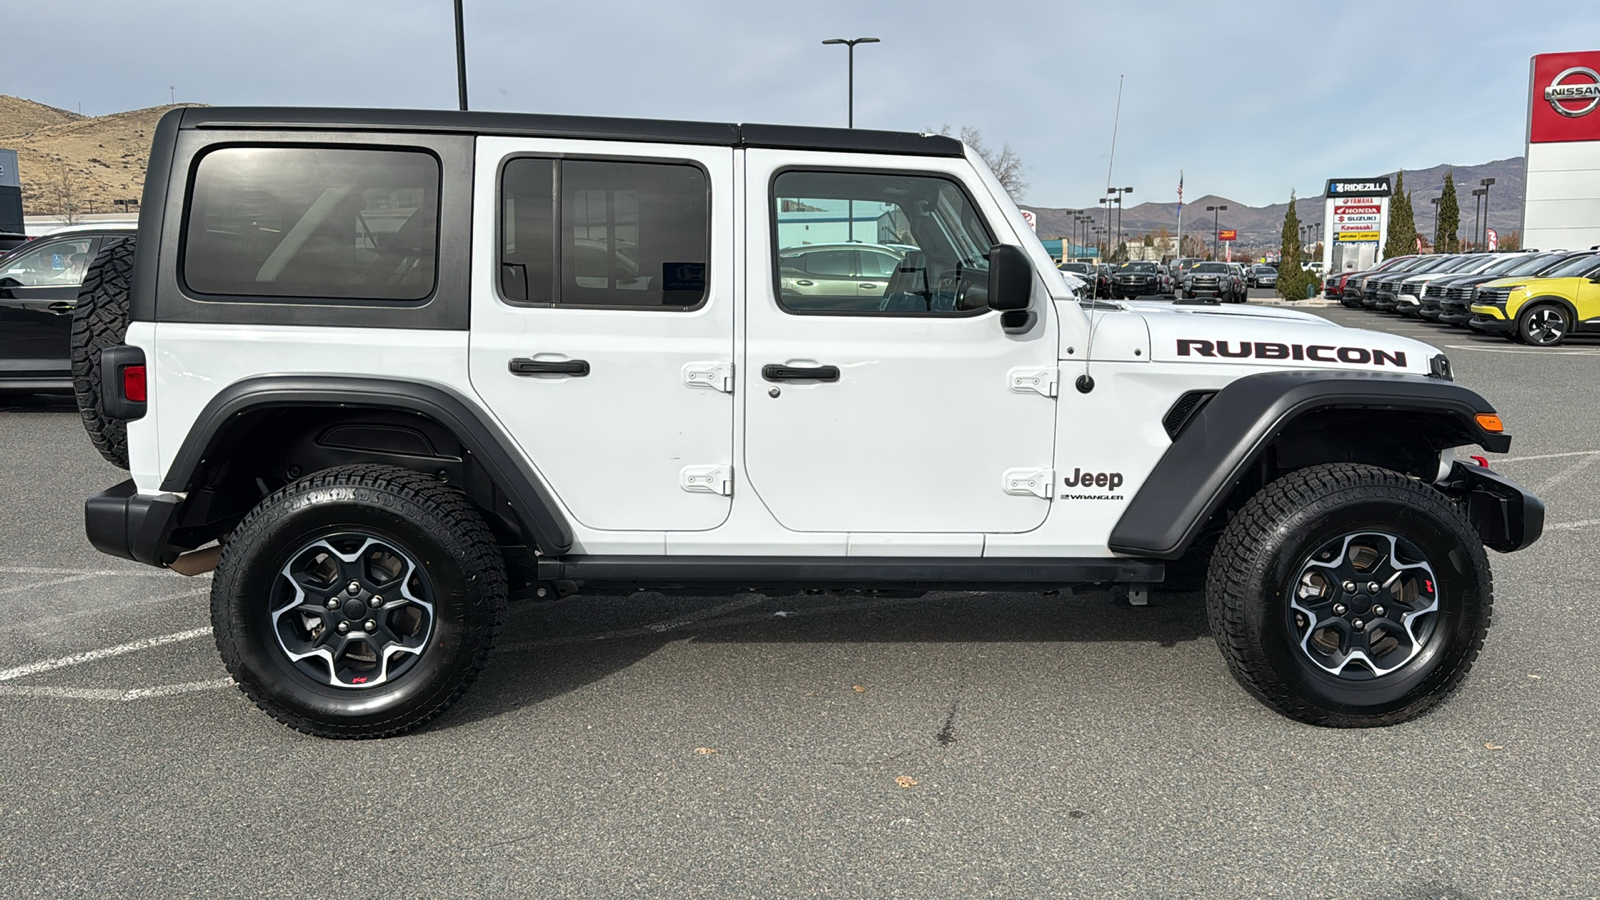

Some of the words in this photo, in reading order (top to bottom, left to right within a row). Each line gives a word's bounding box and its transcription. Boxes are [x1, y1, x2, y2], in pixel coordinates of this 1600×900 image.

[1551, 86, 1600, 96] NISSAN
[1344, 183, 1388, 191] RIDEZILLA
[1176, 339, 1408, 368] RUBICON
[1064, 467, 1124, 491] Jeep
